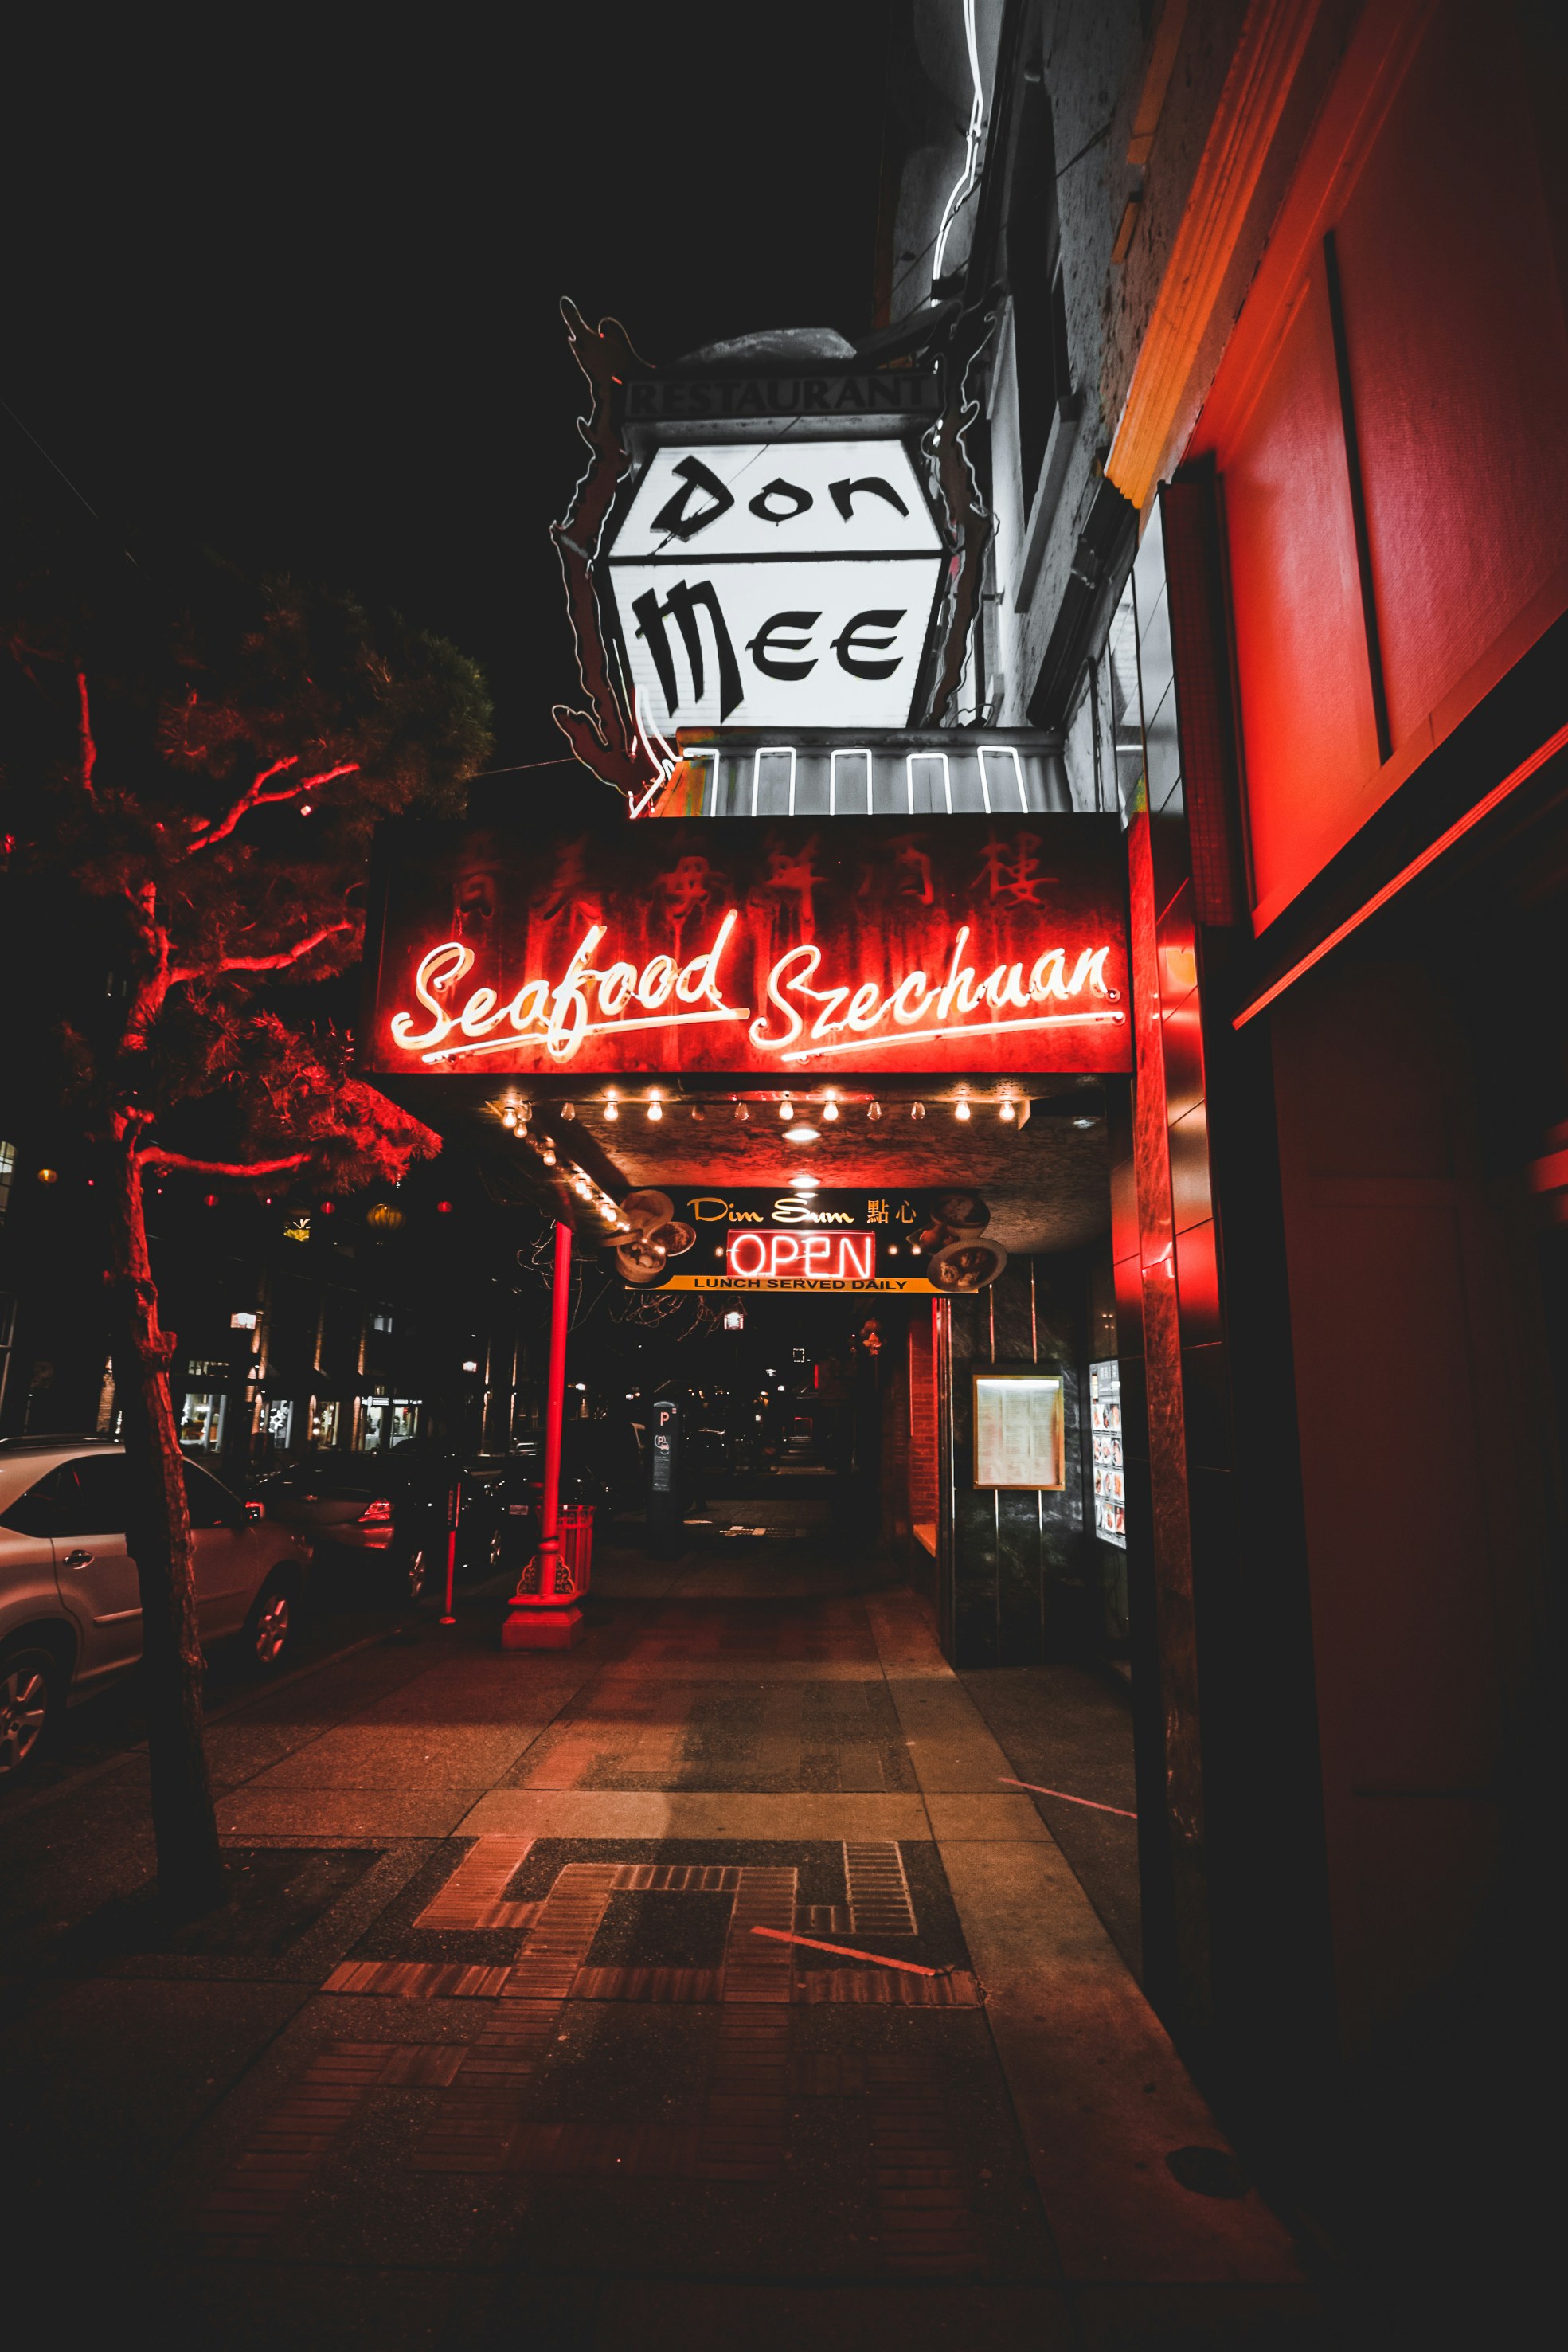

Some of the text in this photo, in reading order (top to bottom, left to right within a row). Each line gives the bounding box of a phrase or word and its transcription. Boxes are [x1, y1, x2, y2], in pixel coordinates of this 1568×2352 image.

[632, 375, 929, 413] RESTAURANT
[392, 910, 1120, 1063] Seafood Szechuan
[688, 1197, 854, 1223] Dim Sum
[866, 1199, 917, 1223] 點心
[731, 1234, 872, 1278] OPEN
[694, 1278, 908, 1289] LUNCH SERVED DAILY
[660, 1411, 670, 1426] P
